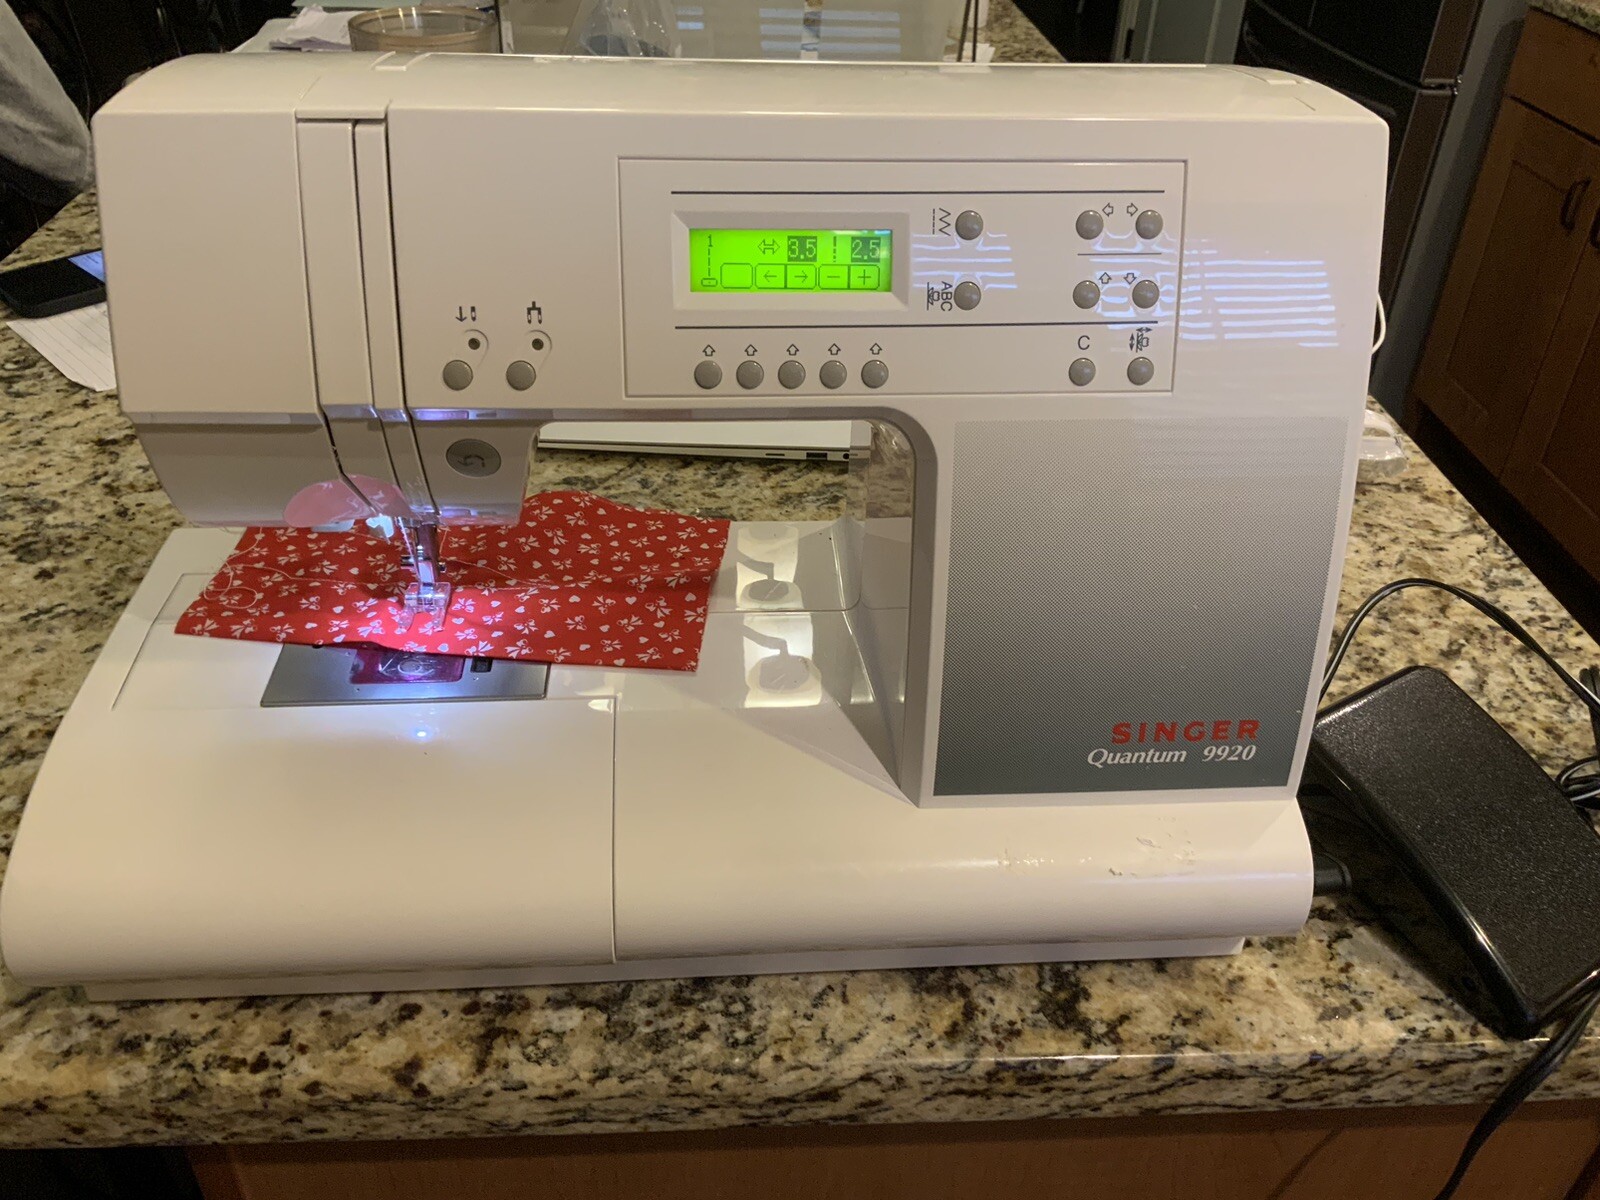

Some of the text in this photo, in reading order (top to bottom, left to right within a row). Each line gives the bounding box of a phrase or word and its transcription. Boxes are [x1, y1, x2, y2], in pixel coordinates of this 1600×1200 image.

[707, 234, 713, 248] 1
[788, 238, 817, 260] 3.5
[851, 239, 880, 260] 2.5
[940, 280, 953, 312] ABC
[1077, 335, 1090, 351] C
[1111, 719, 1260, 744] SINGER
[1087, 744, 1256, 768] Quantum 9920
